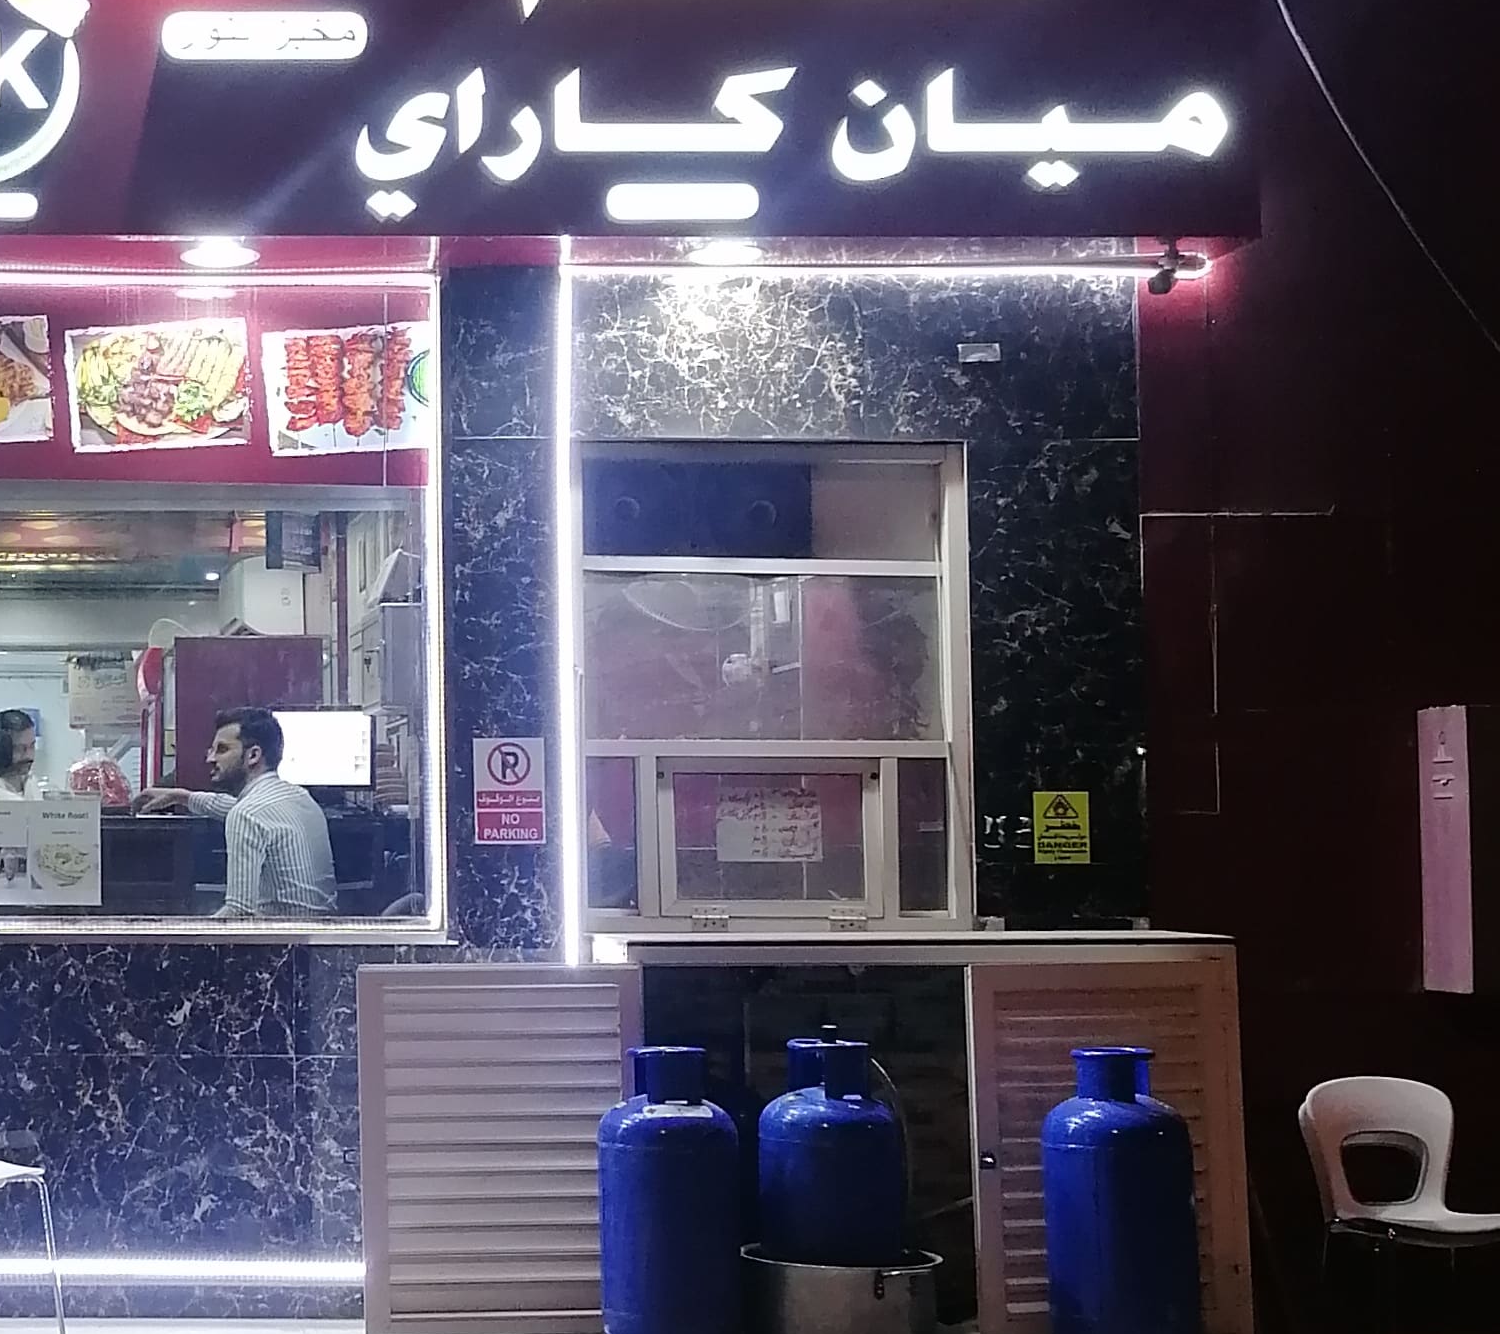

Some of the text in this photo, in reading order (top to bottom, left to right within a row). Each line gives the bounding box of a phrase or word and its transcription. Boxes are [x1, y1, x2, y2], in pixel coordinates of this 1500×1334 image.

[276, 18, 356, 51] مخبز
[831, 67, 1229, 187] ميان
[501, 813, 520, 825] NO
[483, 828, 539, 840] PARKING
[1037, 841, 1088, 849] DANGER
